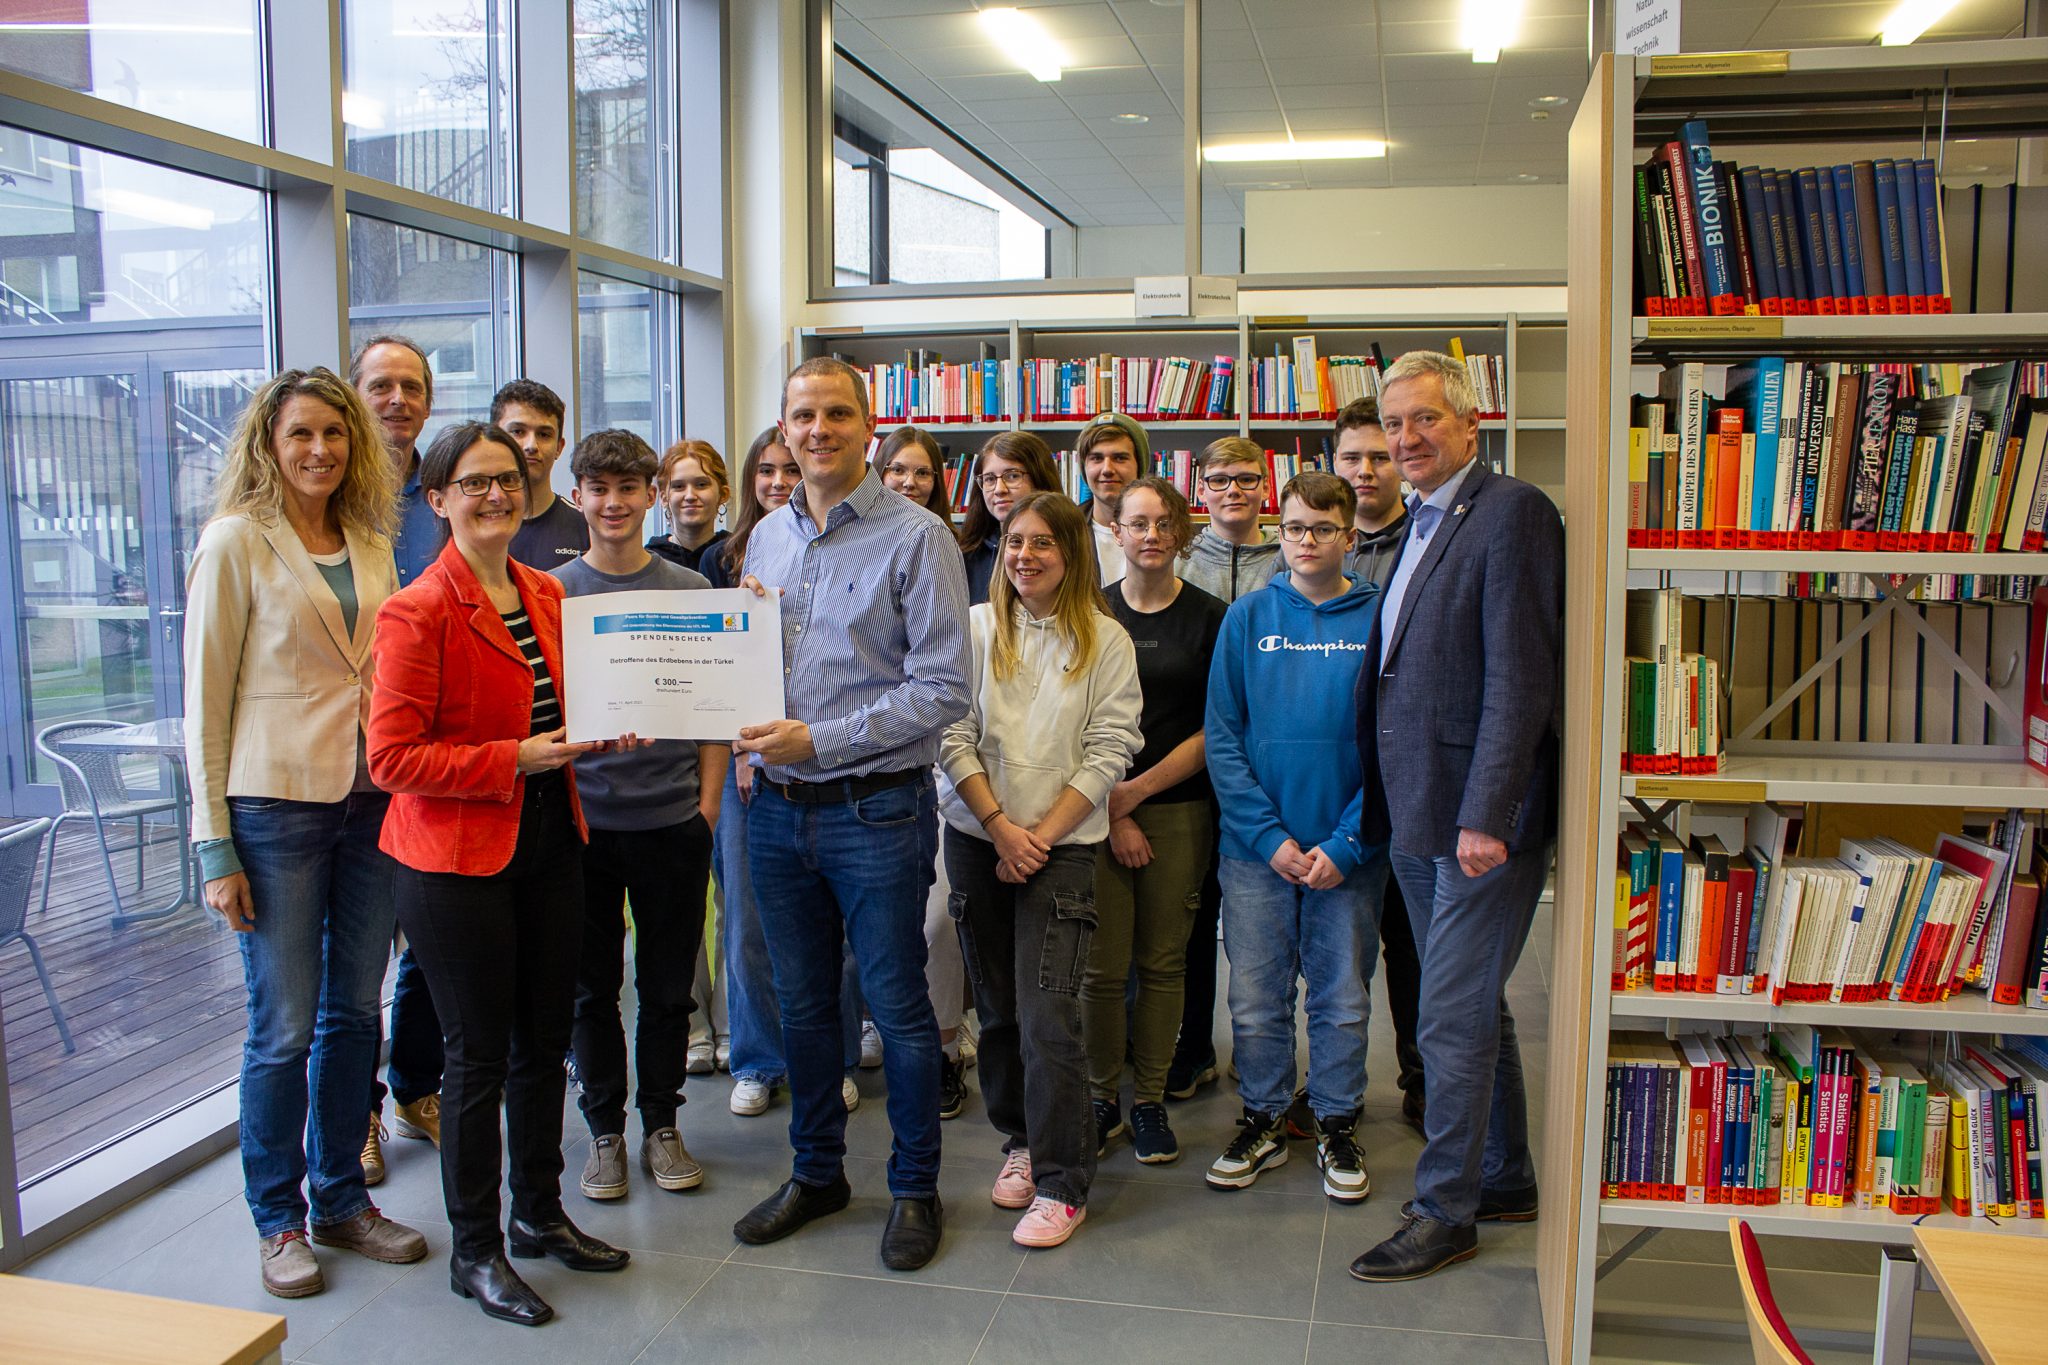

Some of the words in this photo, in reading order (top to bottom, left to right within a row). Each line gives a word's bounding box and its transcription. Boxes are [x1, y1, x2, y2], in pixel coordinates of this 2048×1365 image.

[1626, 9, 1668, 40] wissenschaft
[1634, 36, 1659, 56] Technik
[1672, 147, 1681, 165] WELT
[1662, 168, 1672, 197] Lebens
[1675, 165, 1686, 195] UNSERER
[1680, 196, 1690, 219] RÄTSEL
[1695, 165, 1724, 246] BIONIK
[1683, 220, 1693, 247] LETZTEN
[1771, 214, 1785, 268] UNIVERSUM
[1810, 212, 1824, 267] UNIVERSUM
[1827, 212, 1839, 267] UNIVERSUM
[1845, 210, 1858, 266] UNIVERSUM
[1887, 206, 1901, 262] UNIVERSUM
[1925, 207, 1937, 263] UNIVERSUM
[1760, 370, 1780, 434] MINERALIEN
[1800, 370, 1813, 439] SONNENSYSTEMS
[1840, 384, 1848, 400] DER
[1688, 388, 1700, 446] MENSCHEN
[1835, 399, 1848, 446] GEOLOGISCHE
[1895, 424, 1917, 434] Hass
[1897, 415, 1918, 425] Hans
[1954, 403, 1967, 432] SONNE
[1797, 441, 1807, 457] DES
[1806, 405, 1824, 474] UNIVERSUM
[1893, 435, 1905, 461] zum
[1951, 432, 1960, 447] DIE
[1687, 449, 1697, 468] DES
[1832, 447, 1842, 474] AUFBAU
[1947, 452, 1958, 474] Kaiser
[1682, 471, 1696, 513] KÖRPER
[1793, 459, 1804, 508] EROBERUNG
[1885, 462, 1899, 494] Fisch
[1891, 477, 1907, 532] enschen
[1900, 435, 1914, 476] wurde
[1802, 477, 1817, 513] UNSER
[1826, 474, 1838, 521] ÖSTERREICHS
[1883, 495, 1894, 516] der
[2030, 493, 2048, 526] Classics
[1683, 516, 1694, 530] ER
[1882, 517, 1892, 531] ie
[630, 634, 712, 642] SPENDENSCHECK
[1258, 635, 1366, 657] Champion
[655, 678, 660, 686] €
[1729, 936, 1738, 974] TASCHENBUCH
[1734, 891, 1743, 927] MATHEMATIK
[1966, 900, 1988, 945] Maple
[1613, 1087, 1621, 1137] Anwendungsbeispiele
[1729, 1084, 1737, 1122] MATHEMATIK
[1742, 1085, 1750, 1123] MATHEMATIK
[1801, 1094, 1809, 1126] dummies
[1819, 1091, 1831, 1133] Statistics
[1835, 1093, 1848, 1135] Statistics
[1868, 1099, 1876, 1121] MATLAB
[1880, 1087, 1889, 1128] Mathematik
[1981, 1098, 1992, 1123] ZUFALL
[1624, 1111, 1632, 1148] Formelsammlung
[1714, 1104, 1722, 1143] Numerische
[1982, 1125, 1992, 1139] ZEIT
[2027, 1098, 2036, 1148] Qualitätssicherung
[1847, 1139, 1855, 1159] Zahlen
[1865, 1131, 1874, 1172] Programmieren
[1984, 1140, 1994, 1158] ZAHL
[1878, 1166, 1886, 1186] Stingl
